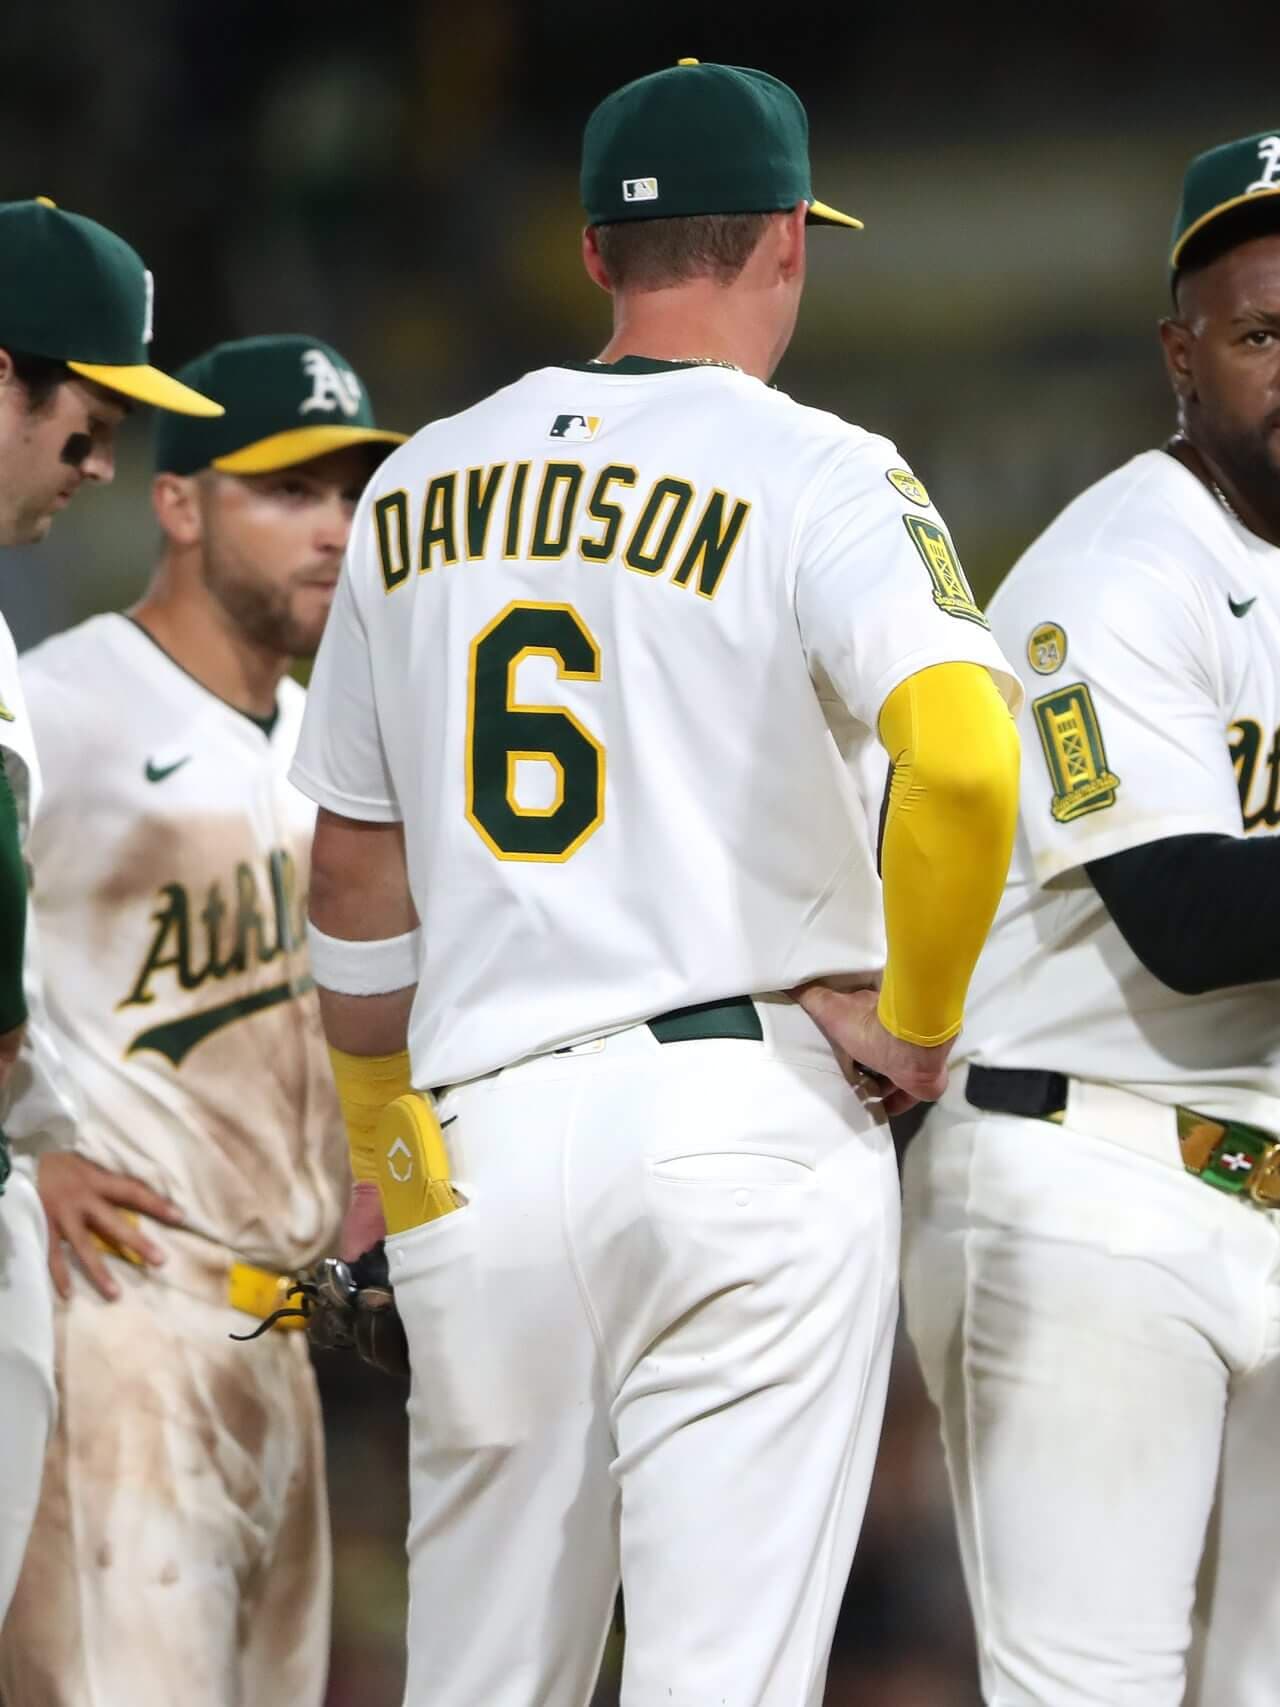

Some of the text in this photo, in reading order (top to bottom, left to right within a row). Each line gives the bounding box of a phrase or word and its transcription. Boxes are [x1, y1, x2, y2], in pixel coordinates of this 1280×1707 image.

[373, 459, 752, 601] DAVIDSON
[464, 599, 607, 864] 6
[114, 850, 308, 1012] Athl
